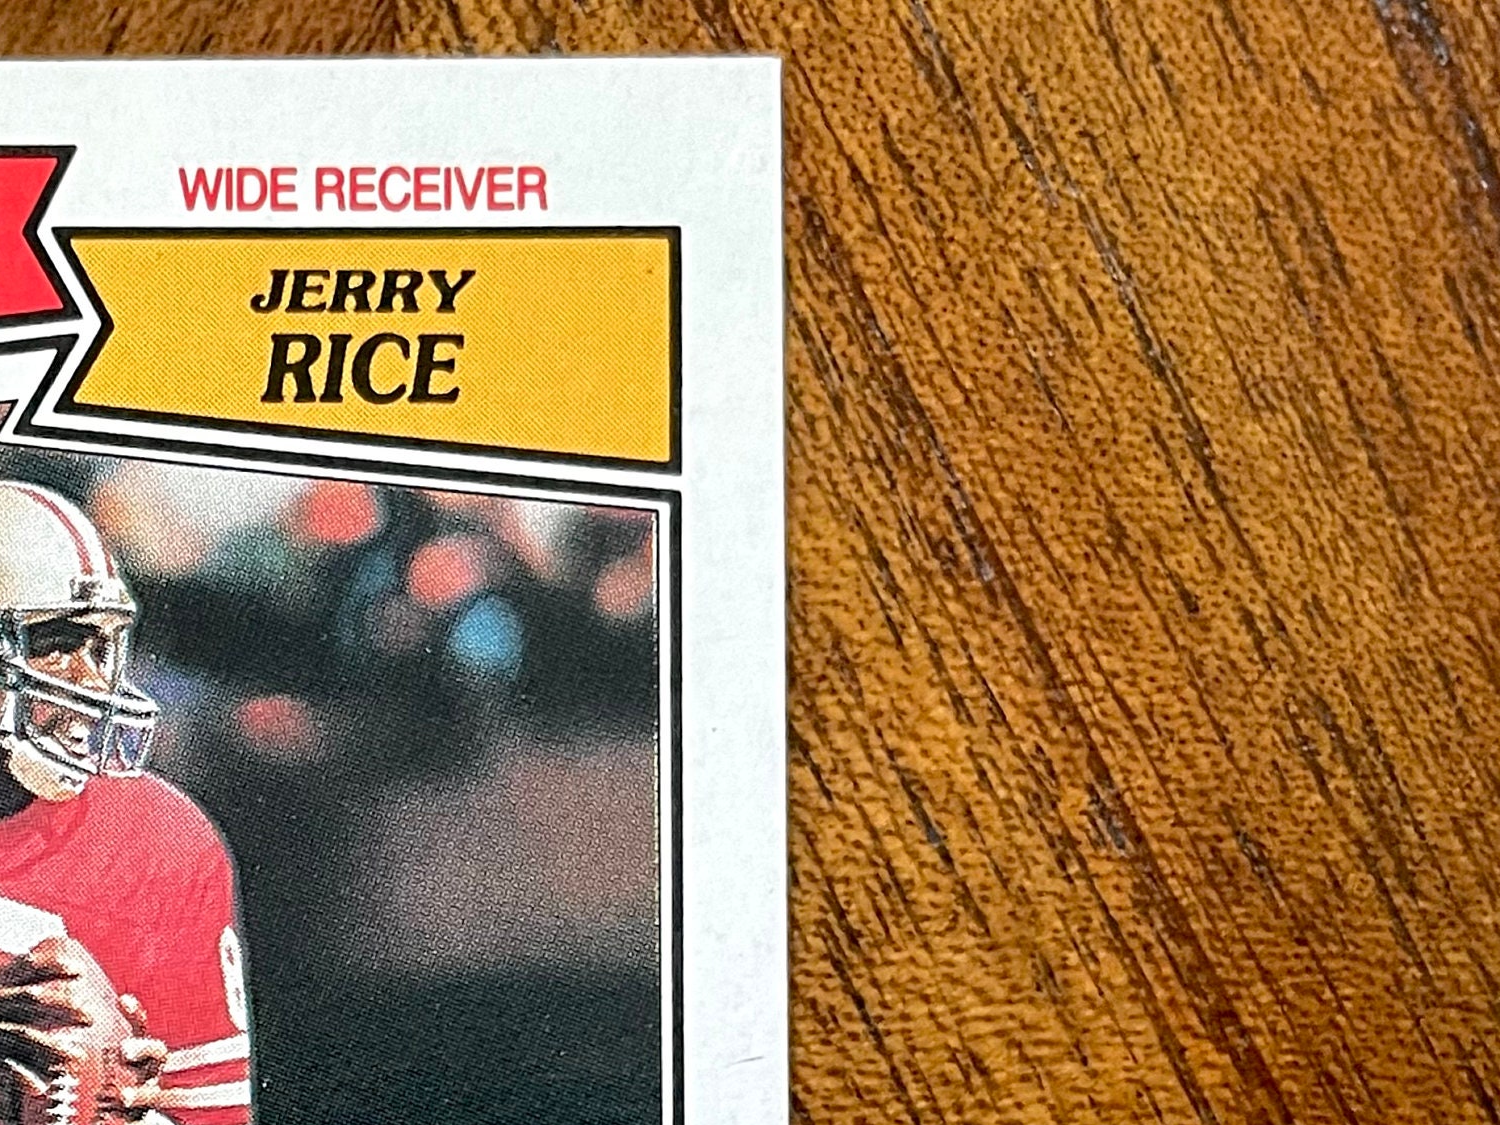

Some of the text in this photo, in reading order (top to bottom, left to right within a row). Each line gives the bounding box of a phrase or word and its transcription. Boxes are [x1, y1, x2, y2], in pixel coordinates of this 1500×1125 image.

[178, 166, 549, 212] WIDE RECEIVER
[249, 268, 476, 315] JERRY
[260, 331, 466, 405] RICE
